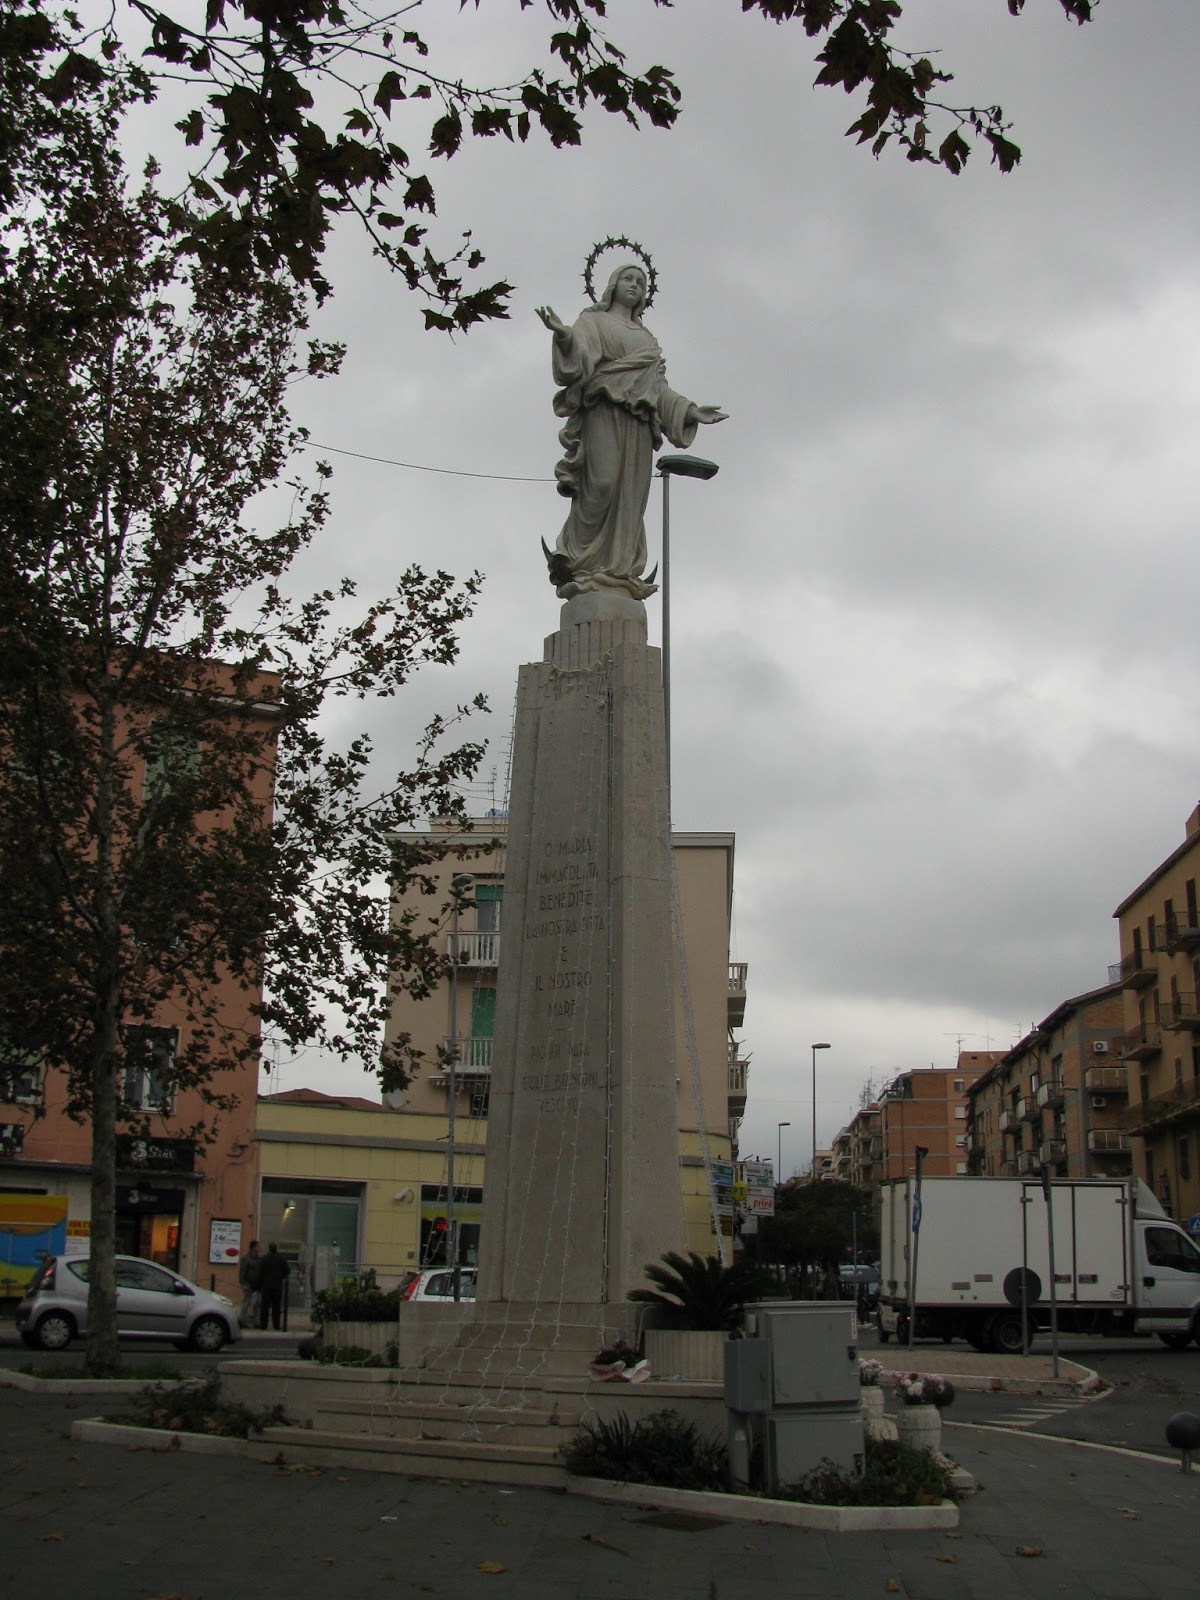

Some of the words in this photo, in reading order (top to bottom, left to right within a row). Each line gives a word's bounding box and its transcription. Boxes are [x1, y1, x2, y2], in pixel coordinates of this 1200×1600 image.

[544, 842, 552, 857] O
[558, 837, 592, 856] MARIA
[536, 862, 598, 885] IMMACOLATA
[539, 890, 592, 911] BENEDITE
[526, 922, 538, 939] LA
[541, 918, 578, 936] NOSTRA
[560, 945, 568, 962] E
[535, 975, 544, 991] IL
[549, 971, 592, 991] NOSTRO
[548, 999, 577, 1018] MARE
